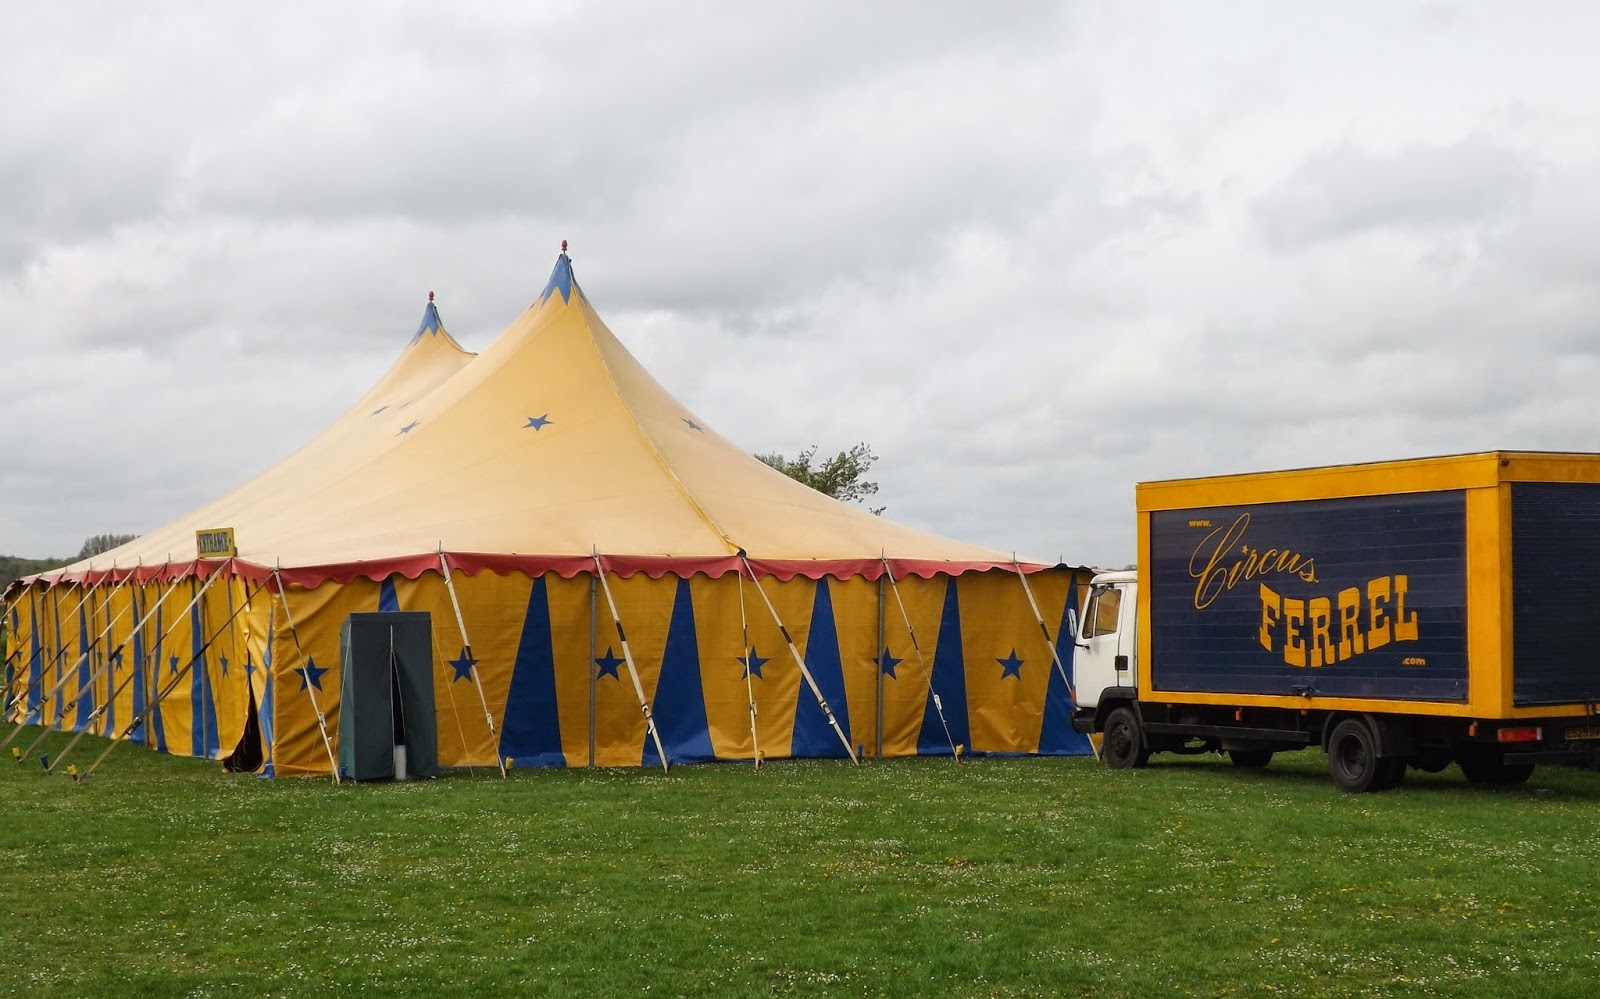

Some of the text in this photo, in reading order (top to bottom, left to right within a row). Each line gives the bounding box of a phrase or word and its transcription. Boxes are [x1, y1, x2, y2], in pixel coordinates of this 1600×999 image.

[1189, 519, 1212, 527] www.
[199, 532, 229, 553] ENTRANCE
[1189, 512, 1319, 609] Circus
[1260, 574, 1419, 667] FERREL
[1402, 656, 1426, 666] .com
